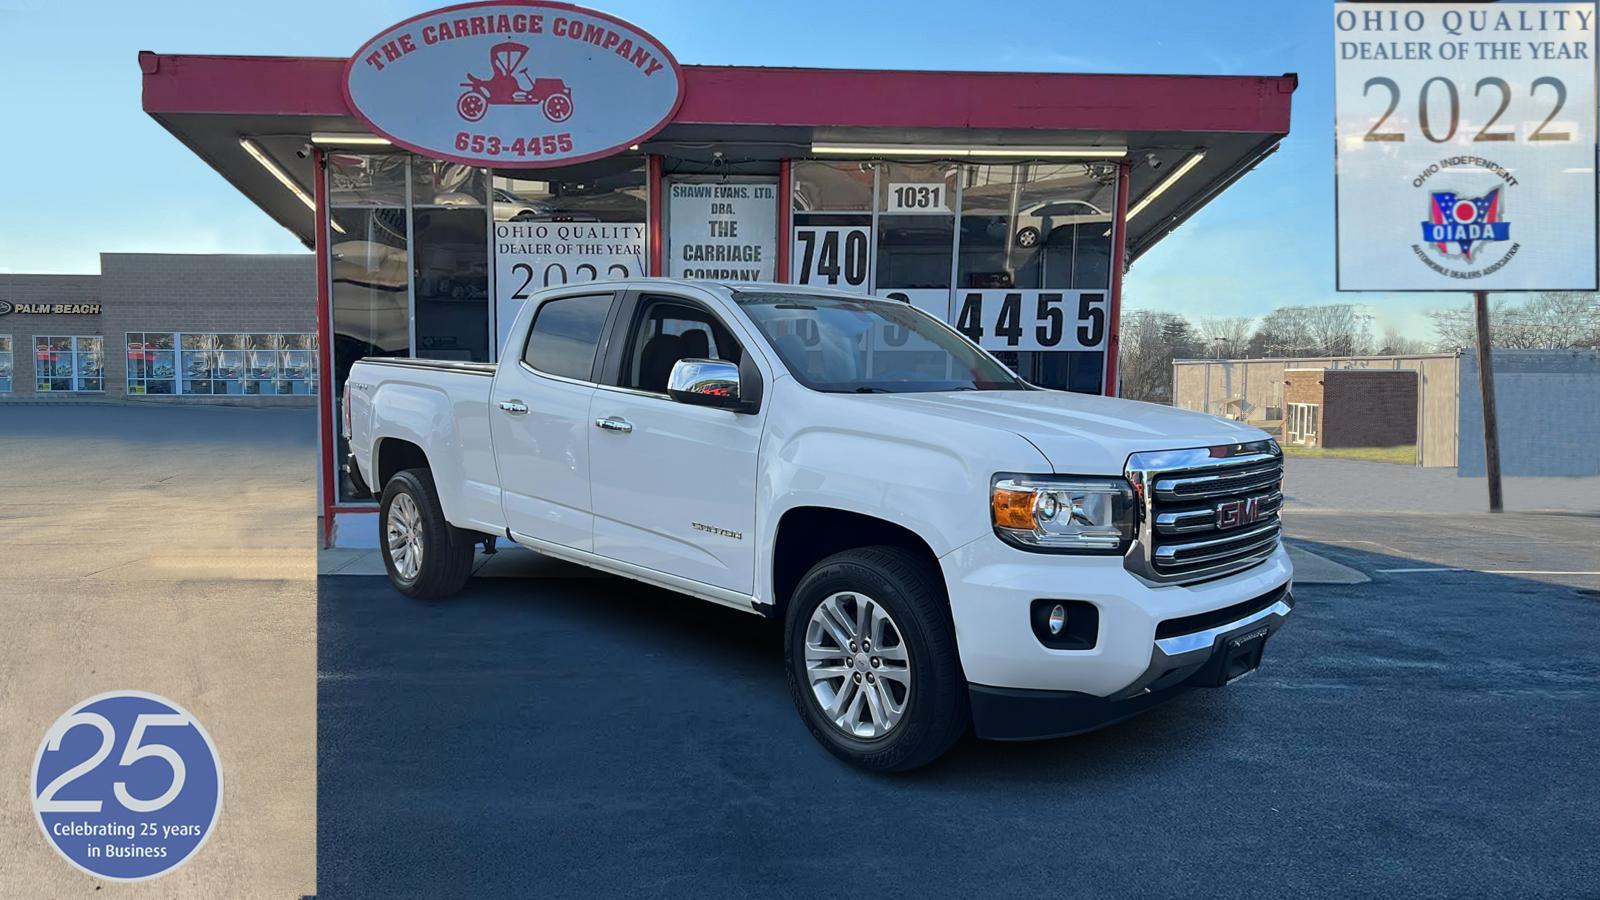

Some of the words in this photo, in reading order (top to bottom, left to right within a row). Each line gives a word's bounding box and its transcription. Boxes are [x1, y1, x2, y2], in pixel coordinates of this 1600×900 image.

[1336, 10, 1425, 31] OHIO
[1442, 10, 1592, 36] QUALITY
[366, 33, 416, 72] THE
[422, 14, 544, 46] CARRIAGE
[552, 16, 664, 77] COMPANY
[1340, 42, 1433, 60] DEALER
[1439, 42, 1469, 60] OF
[1475, 42, 1521, 60] THE
[1528, 42, 1589, 60] YEAR
[1362, 76, 1571, 144] 2022
[455, 132, 573, 156] 653-4455
[1412, 164, 1439, 188] OHIO
[1439, 155, 1519, 188] INDEPENDENT
[673, 185, 711, 198] SHAWN
[754, 187, 774, 199] LTD.
[894, 186, 940, 208] 1031
[711, 203, 736, 215] DBA.
[497, 226, 548, 239] OHIO
[557, 226, 644, 241] QUALITY
[708, 221, 738, 238] THE
[1432, 224, 1495, 240] OIADA
[500, 243, 552, 255] DEALER
[555, 244, 574, 255] OF
[576, 244, 603, 255] THE
[607, 244, 641, 255] YEAR
[683, 244, 762, 262] CARRIAGE
[797, 229, 868, 286] 740
[15, 303, 51, 314] PALM
[54, 303, 100, 314] BEACH
[956, 293, 1104, 347] 4455
[1216, 495, 1269, 530] GMC
